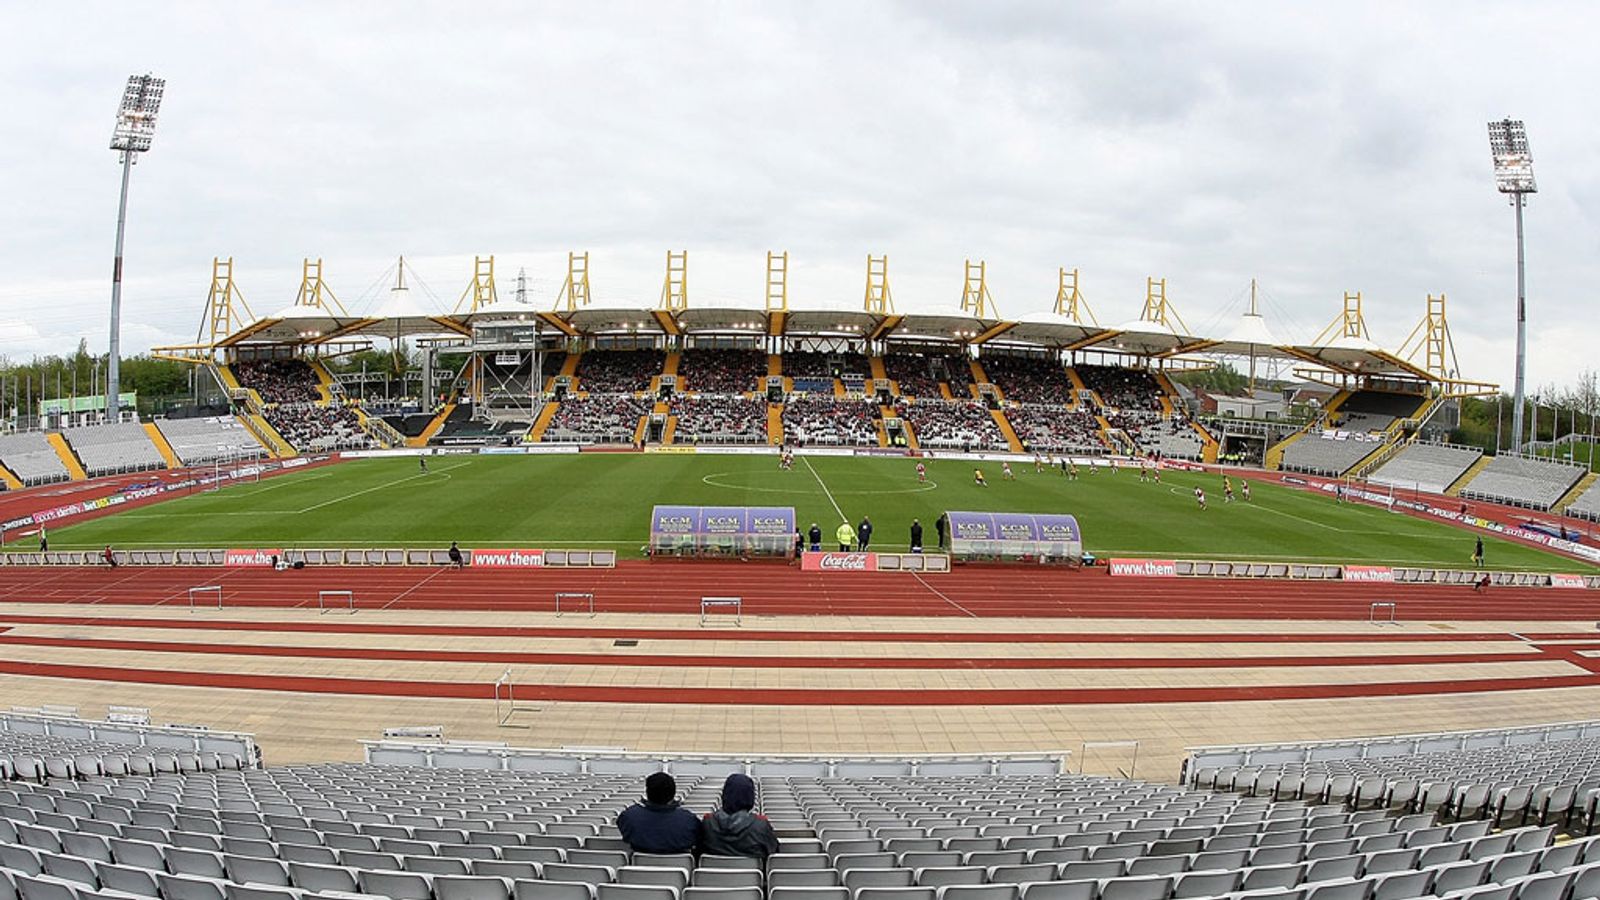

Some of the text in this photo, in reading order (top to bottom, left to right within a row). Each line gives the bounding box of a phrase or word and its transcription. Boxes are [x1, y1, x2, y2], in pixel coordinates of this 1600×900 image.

[475, 552, 542, 566] www.them
[820, 554, 867, 569] Coca-Cola
[1112, 562, 1173, 575] www.them
